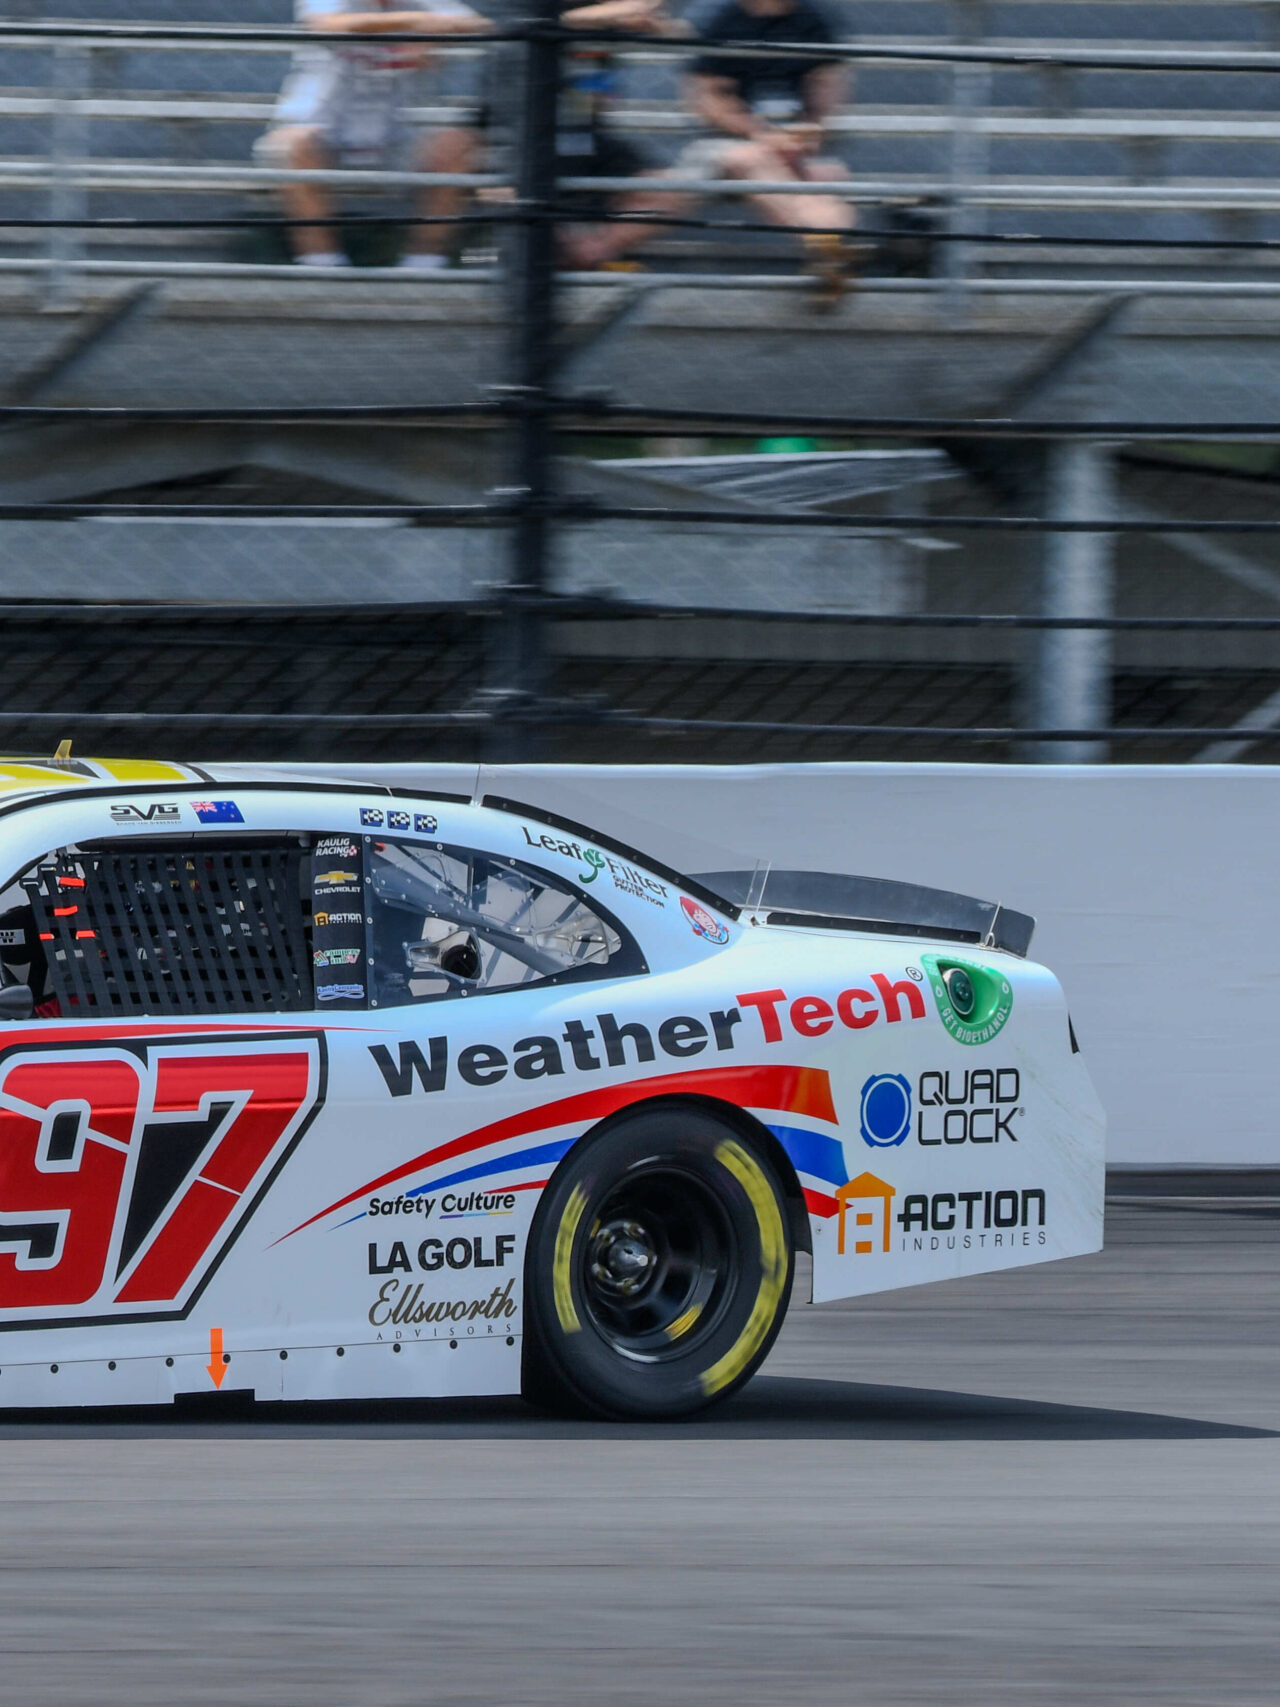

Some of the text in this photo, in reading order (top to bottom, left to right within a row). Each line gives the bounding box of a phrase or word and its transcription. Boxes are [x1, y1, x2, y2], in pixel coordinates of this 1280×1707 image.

[111, 803, 179, 820] SVG
[316, 847, 350, 857] RACING
[317, 838, 350, 848] KAULIG
[315, 886, 361, 895] CHEVROLET
[942, 1007, 959, 1031] GET
[955, 1006, 1009, 1043] BIOETHANOL
[919, 1068, 1019, 1107] QUAD
[918, 1107, 1019, 1146] LOCK
[368, 1192, 516, 1219] Safety Culture
[897, 1188, 1046, 1232] ACTION
[902, 1231, 1046, 1252] INDUSTRIES
[368, 1234, 516, 1275] LA GOLF
[368, 1278, 518, 1326] Ellsworth
[376, 1324, 512, 1341] ADVISORS
